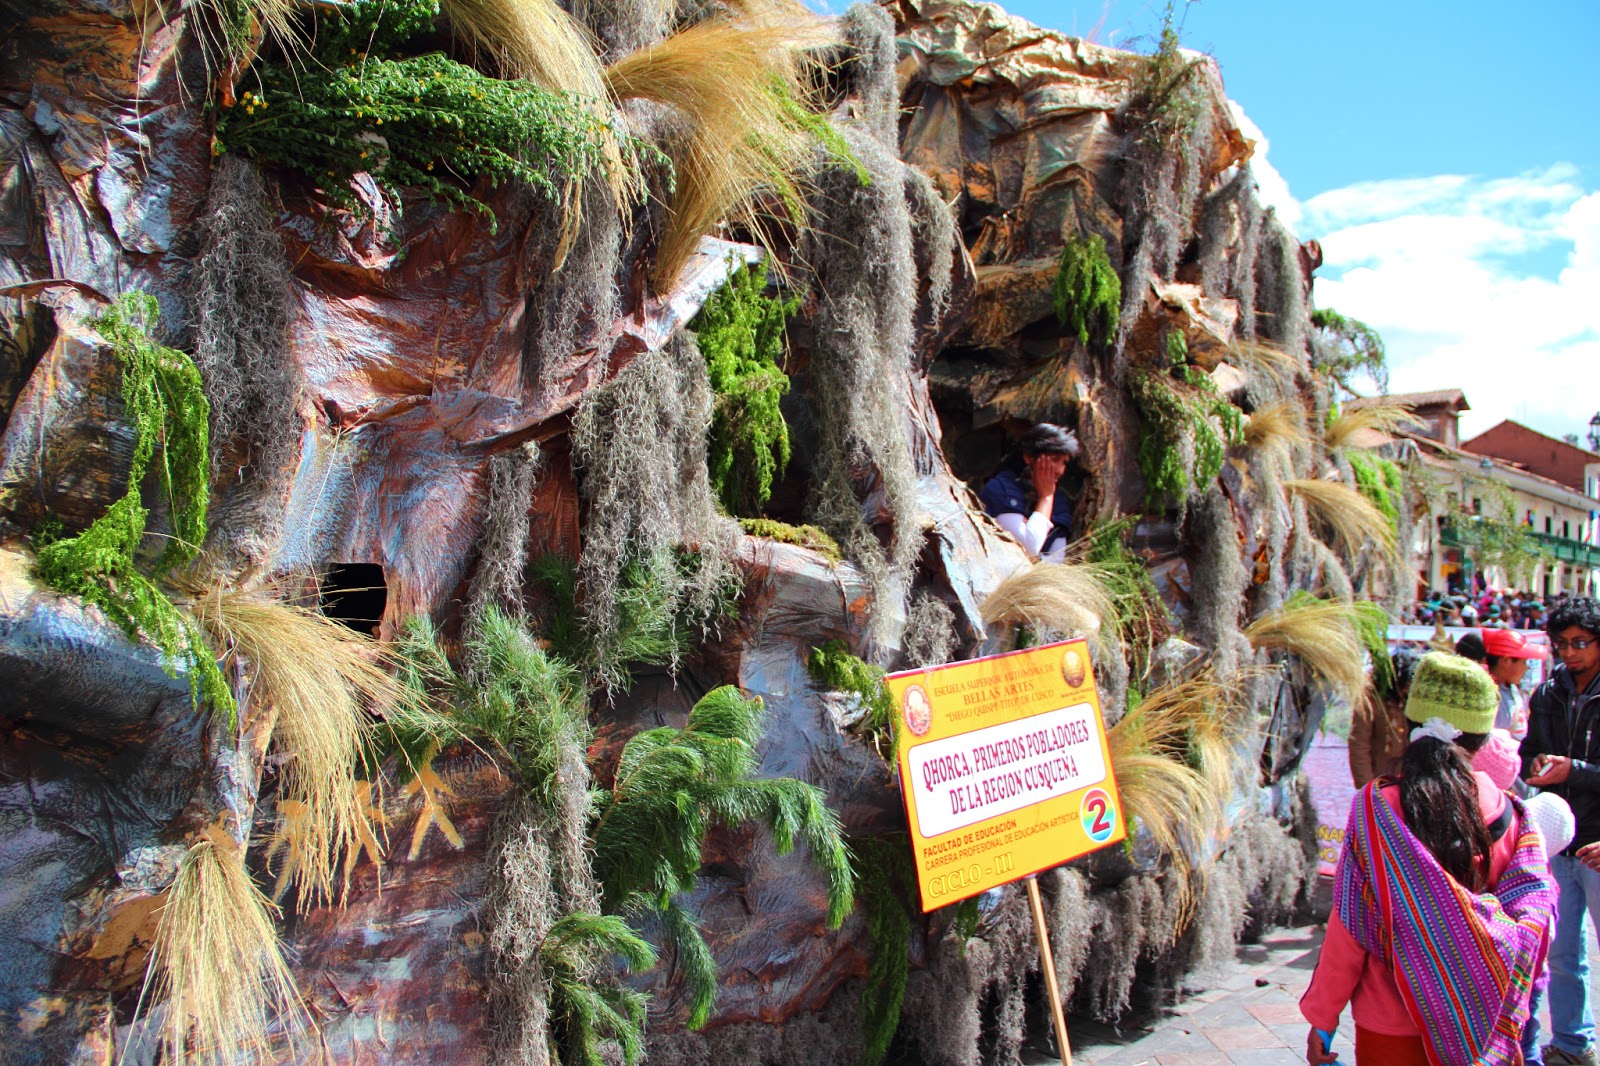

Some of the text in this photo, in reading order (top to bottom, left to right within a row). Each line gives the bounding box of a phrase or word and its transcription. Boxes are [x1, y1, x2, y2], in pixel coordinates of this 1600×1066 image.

[934, 683, 965, 697] ESCUELA
[967, 675, 1001, 689] SUPERIOR
[1045, 663, 1055, 673] DE
[963, 680, 1034, 706] BELLAS ARTES
[974, 702, 999, 717] QUISPE
[1020, 694, 1030, 705] DE
[1031, 689, 1054, 703] CUSCO
[922, 719, 1090, 792] QHORCA, PRIMEROS POBLADORES
[949, 750, 1079, 815] DE LA REGION CUSQUEÑA
[1088, 799, 1110, 833] 2
[923, 819, 1018, 858] FACULTAD DE EDUCACIÓN
[925, 854, 958, 871] CARRERA
[958, 839, 1004, 860] PROFESIONAL
[1004, 834, 1014, 844] DE
[1014, 821, 1049, 841] EDUCACIÓN
[928, 864, 982, 898] CICLO
[993, 852, 1015, 876] III
